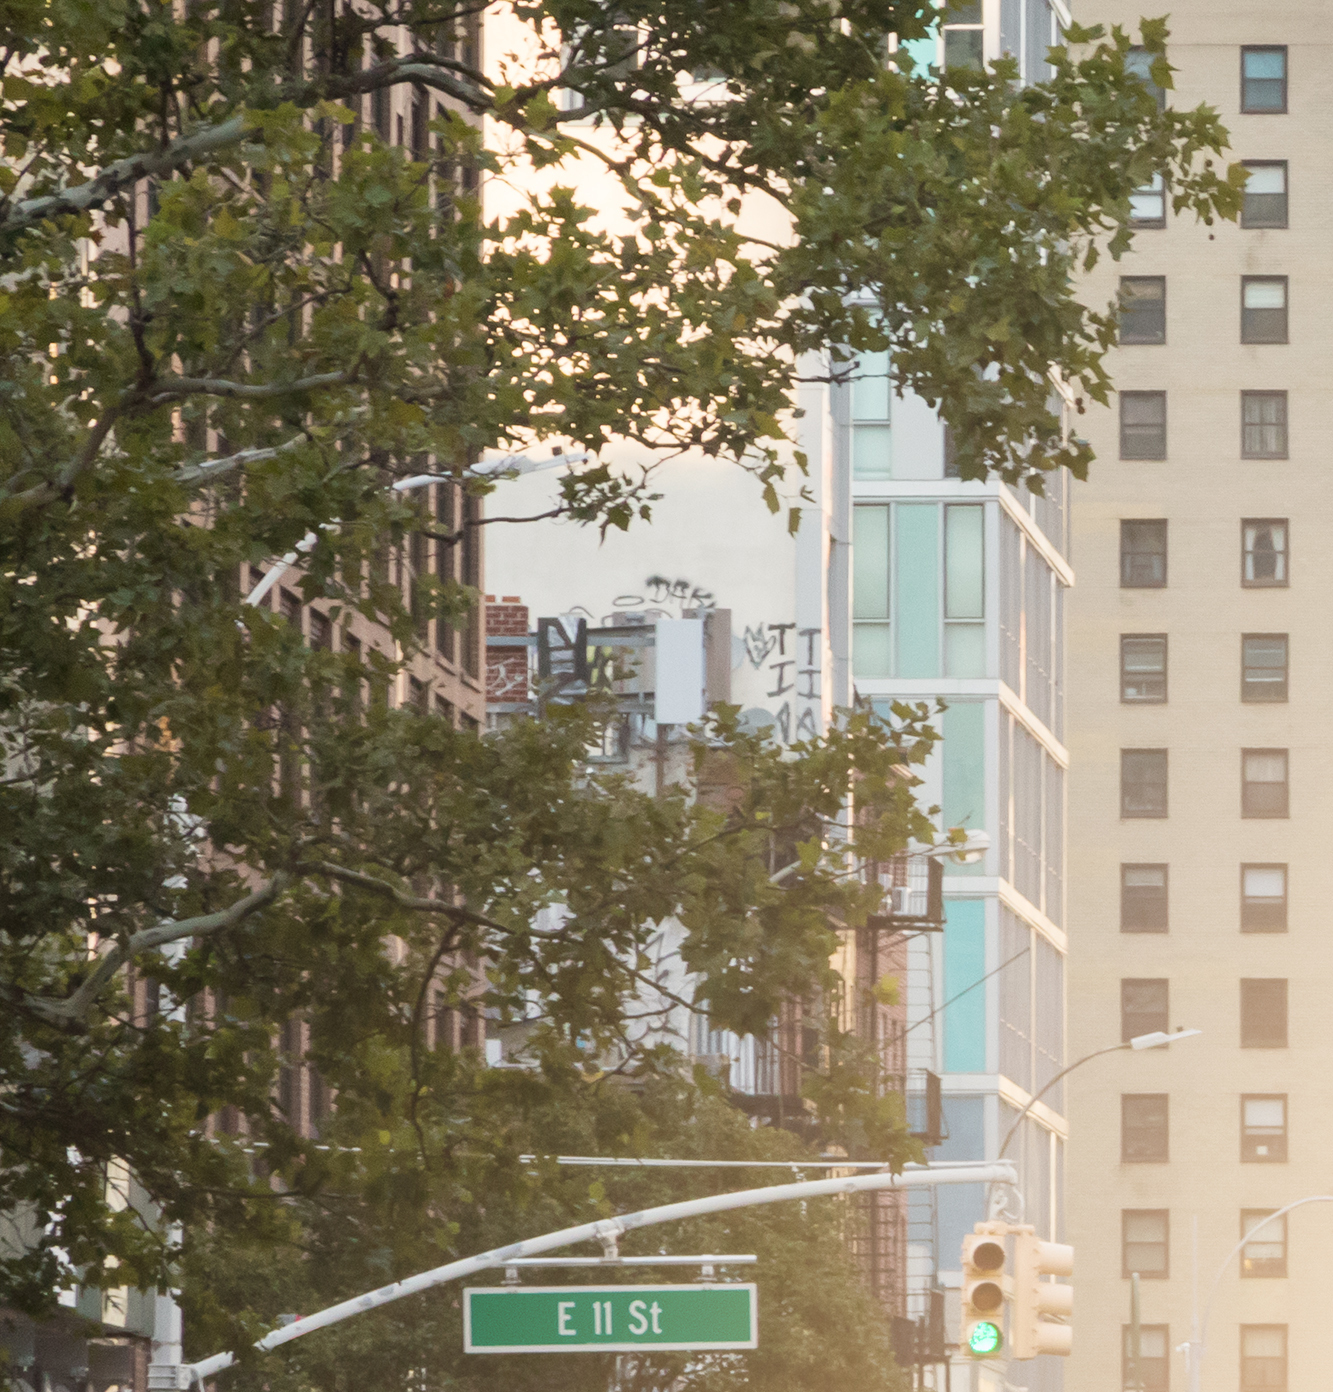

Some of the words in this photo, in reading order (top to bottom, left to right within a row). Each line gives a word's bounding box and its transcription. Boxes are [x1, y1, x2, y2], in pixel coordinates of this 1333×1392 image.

[558, 1301, 577, 1336] E
[592, 1301, 613, 1335] 11
[628, 1300, 663, 1335] St
